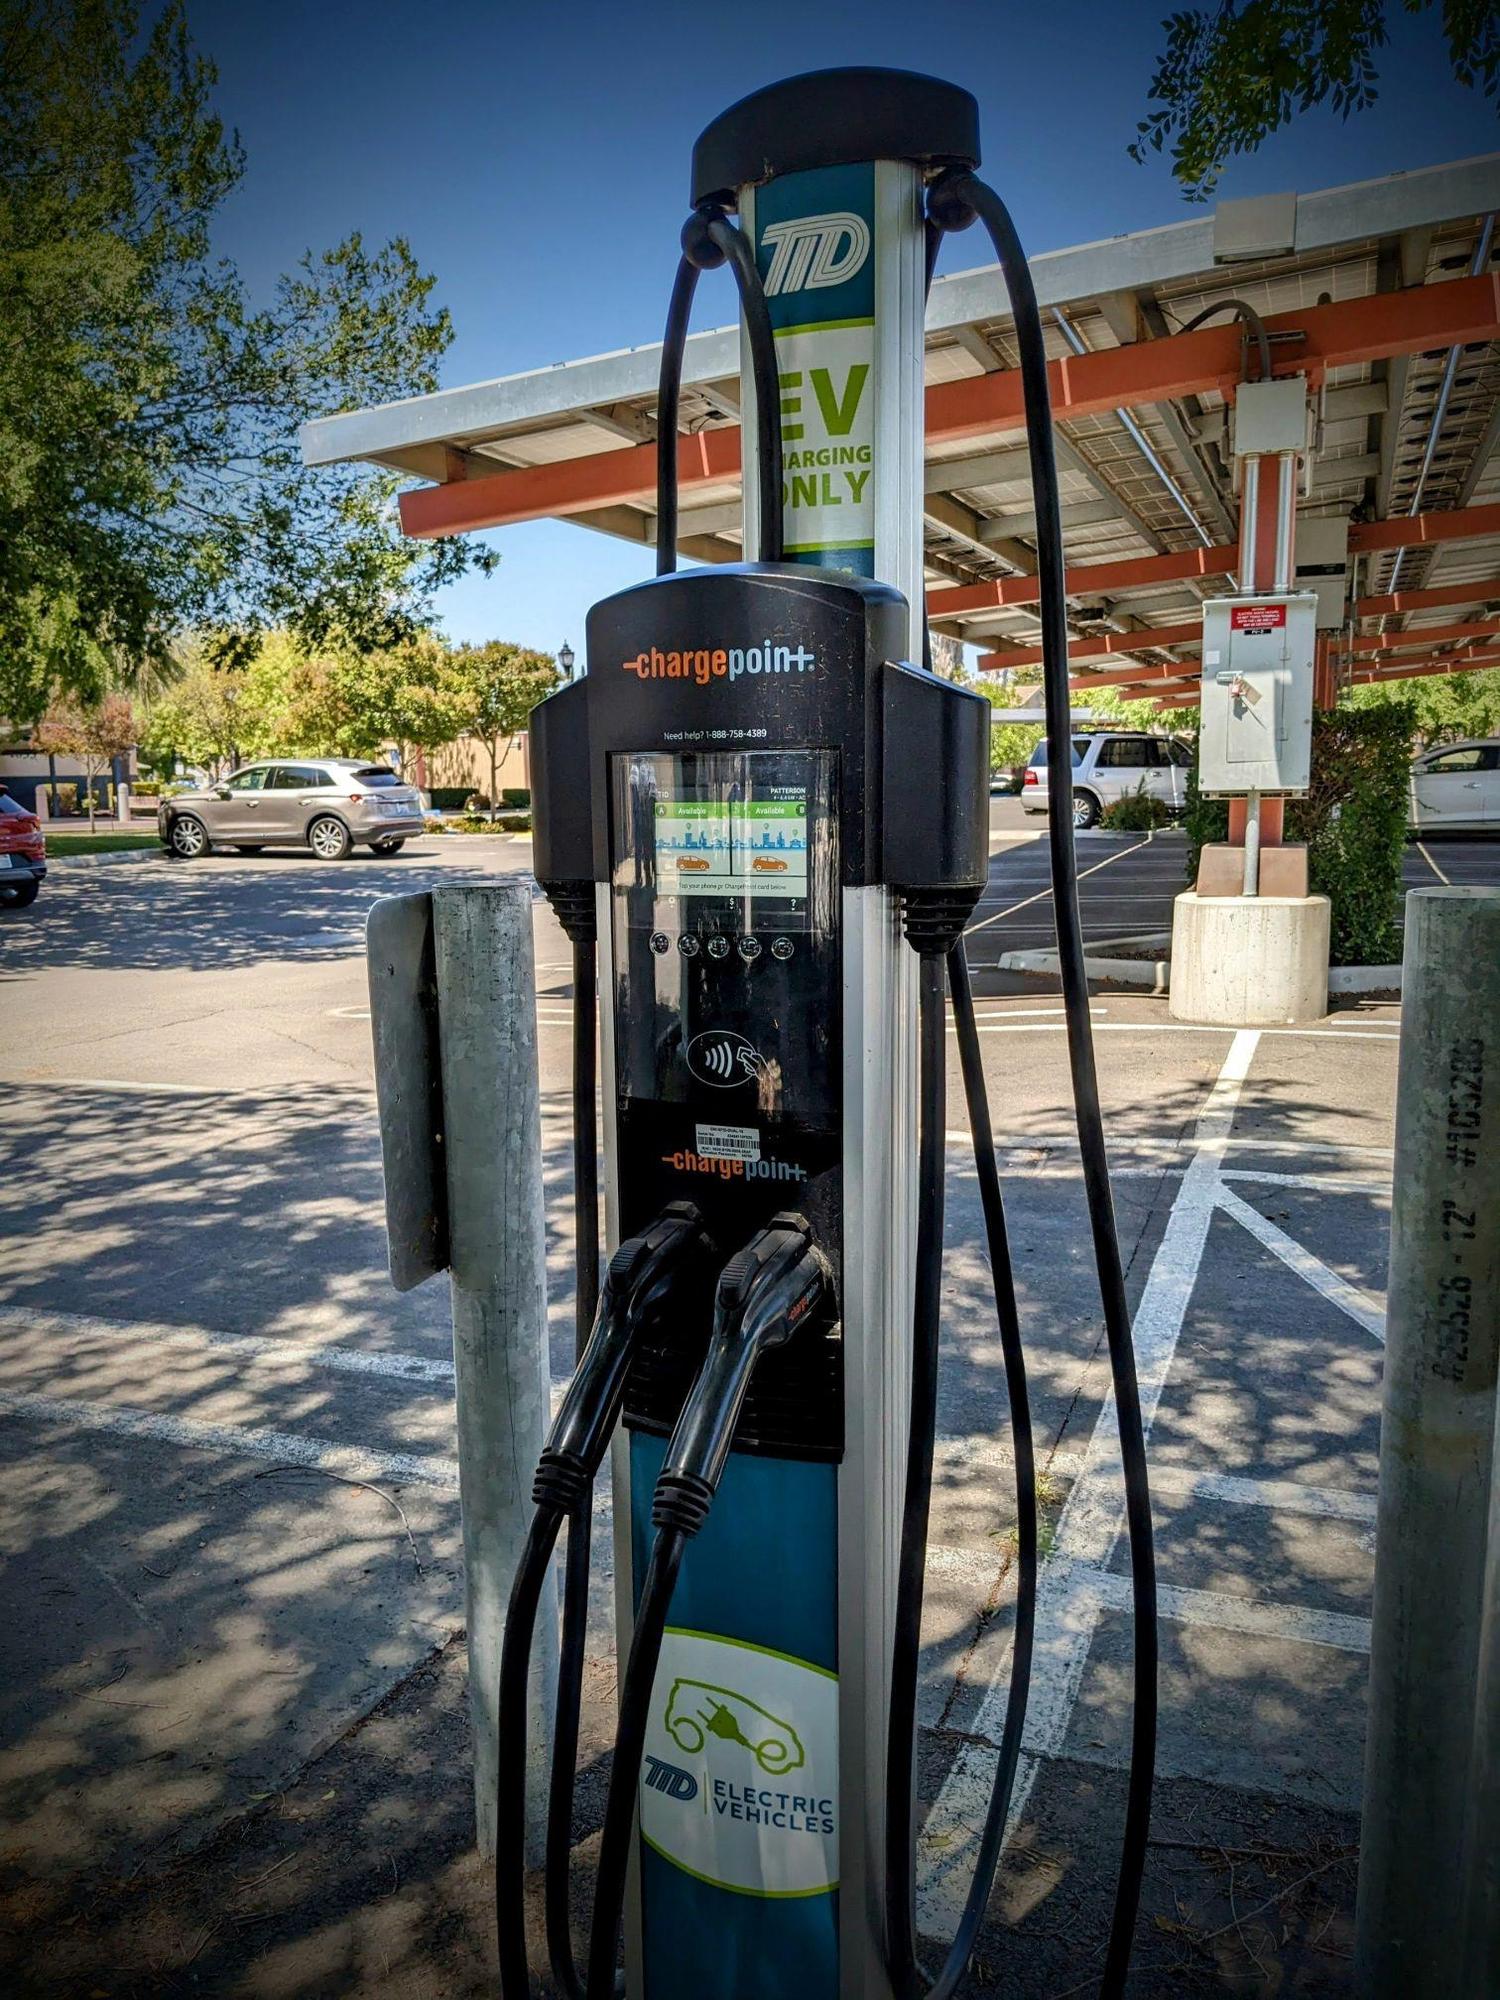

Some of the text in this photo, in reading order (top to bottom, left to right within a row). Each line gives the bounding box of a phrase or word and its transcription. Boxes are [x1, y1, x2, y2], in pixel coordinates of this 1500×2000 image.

[761, 211, 870, 297] TID
[779, 364, 870, 441] EV
[783, 445, 871, 470] ARGING
[783, 470, 871, 508] NLY
[663, 728, 767, 741] Need help? 1-888-758-4389
[770, 787, 806, 795] PATTERSON
[678, 807, 707, 816] Available
[755, 807, 785, 816] Available
[645, 1755, 698, 1801] TID
[714, 1779, 833, 1815] ELECTRIC
[713, 1797, 834, 1834] VEHICLES
